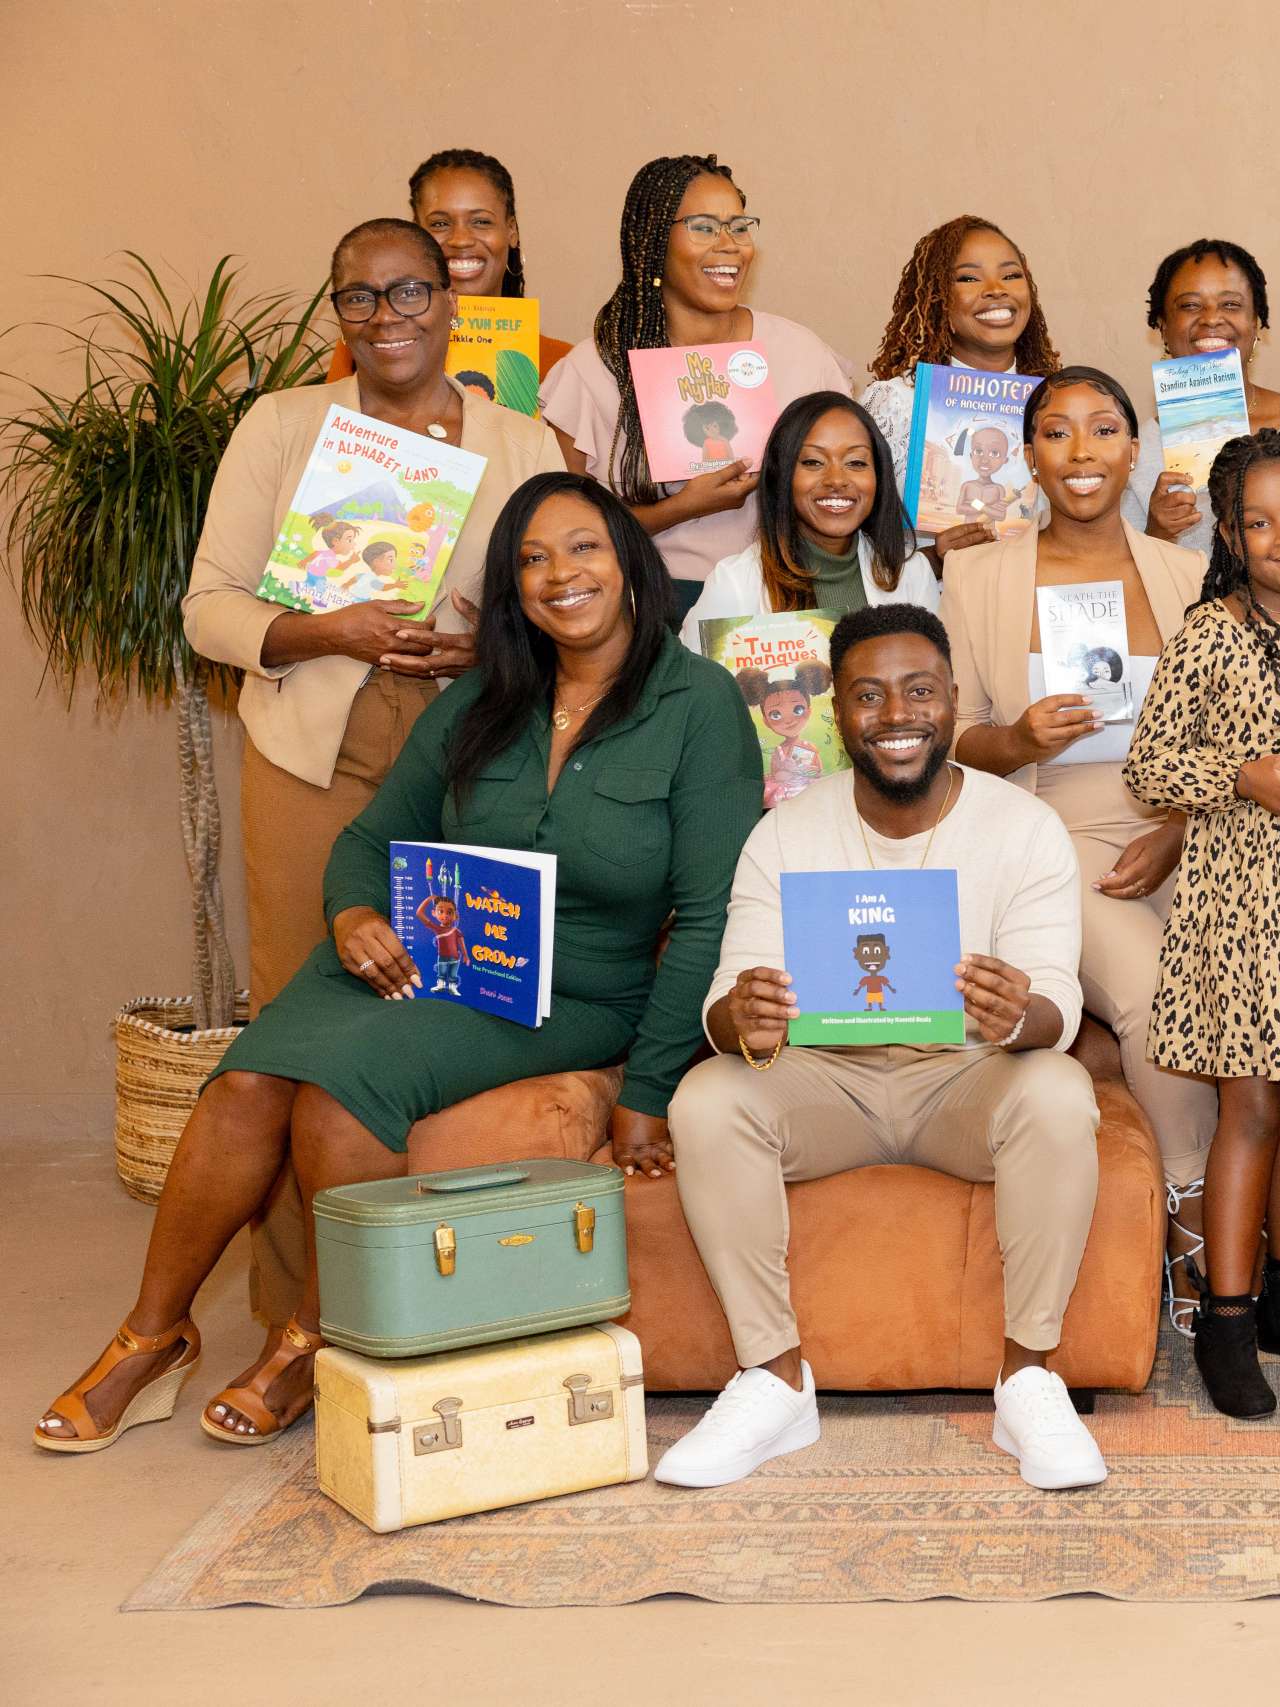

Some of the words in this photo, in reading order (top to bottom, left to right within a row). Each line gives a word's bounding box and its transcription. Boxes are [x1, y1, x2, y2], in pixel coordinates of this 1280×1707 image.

[496, 319, 522, 331] SELF
[477, 335, 492, 344] One
[686, 351, 712, 380] Me
[677, 376, 705, 404] My
[704, 374, 730, 400] Hair
[949, 374, 1033, 401] IMHOTEP
[1160, 380, 1187, 393] Standing
[1189, 375, 1213, 388] Against
[1213, 372, 1237, 384] Racism
[945, 397, 957, 408] OF
[1000, 404, 1025, 417] KEME
[330, 416, 399, 451] Adventure
[322, 437, 334, 449] in
[337, 440, 401, 476] ALPHABET
[404, 466, 440, 482] LAND
[744, 637, 771, 656] Tu
[778, 638, 805, 653] me
[736, 648, 818, 669] manques
[465, 891, 521, 920] WATCH
[878, 894, 887, 903] A
[848, 906, 897, 925] KING
[484, 922, 508, 942] ME
[471, 944, 517, 969] GROW
